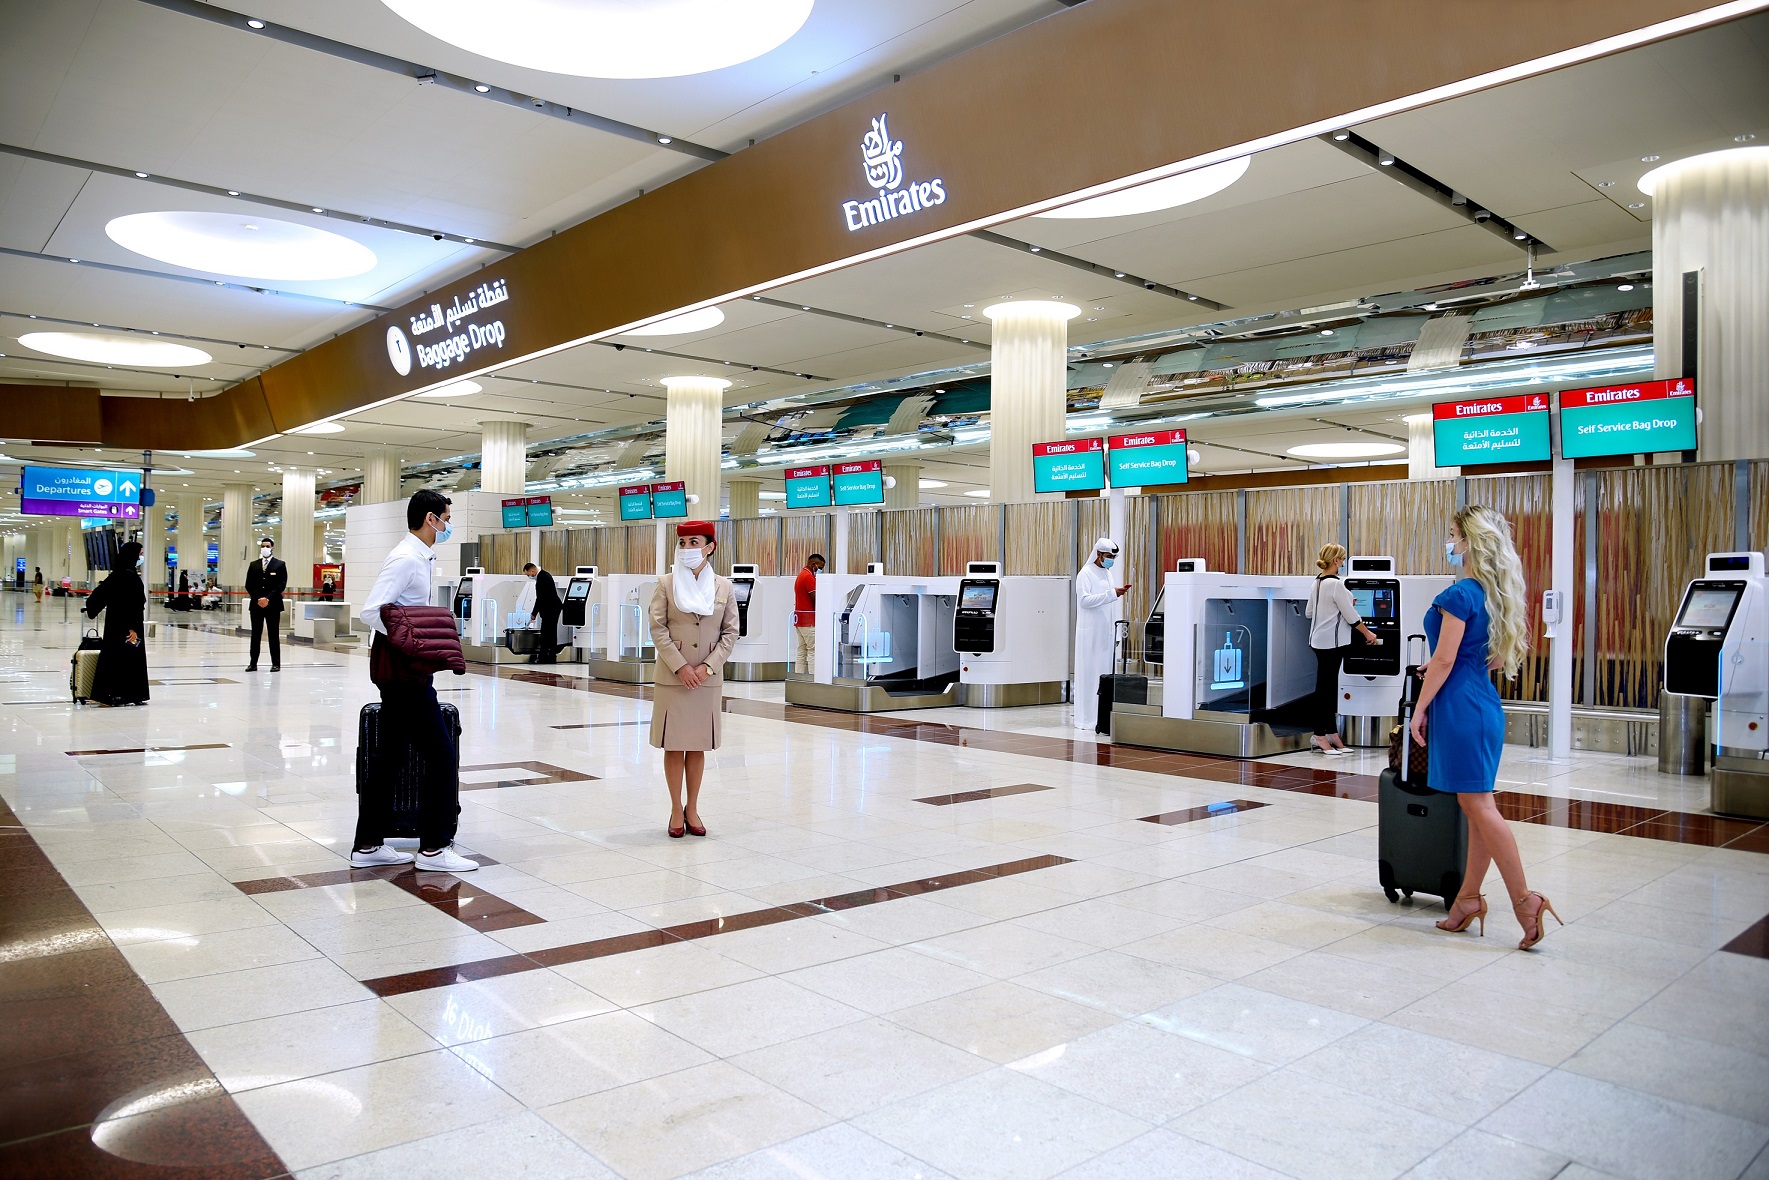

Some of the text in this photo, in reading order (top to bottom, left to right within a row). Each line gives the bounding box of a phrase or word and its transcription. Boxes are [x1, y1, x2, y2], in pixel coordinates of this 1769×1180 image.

[842, 177, 948, 232] Emirates
[410, 278, 509, 336] نقطة تسليم الأمتعة
[416, 320, 506, 369] Baggage Drop
[1586, 388, 1640, 403] Emirates
[1669, 389, 1692, 397] Emirates
[1455, 402, 1503, 416] Emirates
[1577, 418, 1677, 435] Self Service Bag Drop
[1463, 427, 1518, 440] الخدمة الذاتية
[1123, 435, 1156, 447] Emirates
[1462, 438, 1521, 450] لتسليم الأمتعة
[1046, 443, 1076, 453] Emirates
[1119, 459, 1176, 470] Self Service Bag Drop
[54, 476, 91, 485] المغادرون
[36, 484, 91, 496] Departures
[1236, 629, 1245, 643] 7
